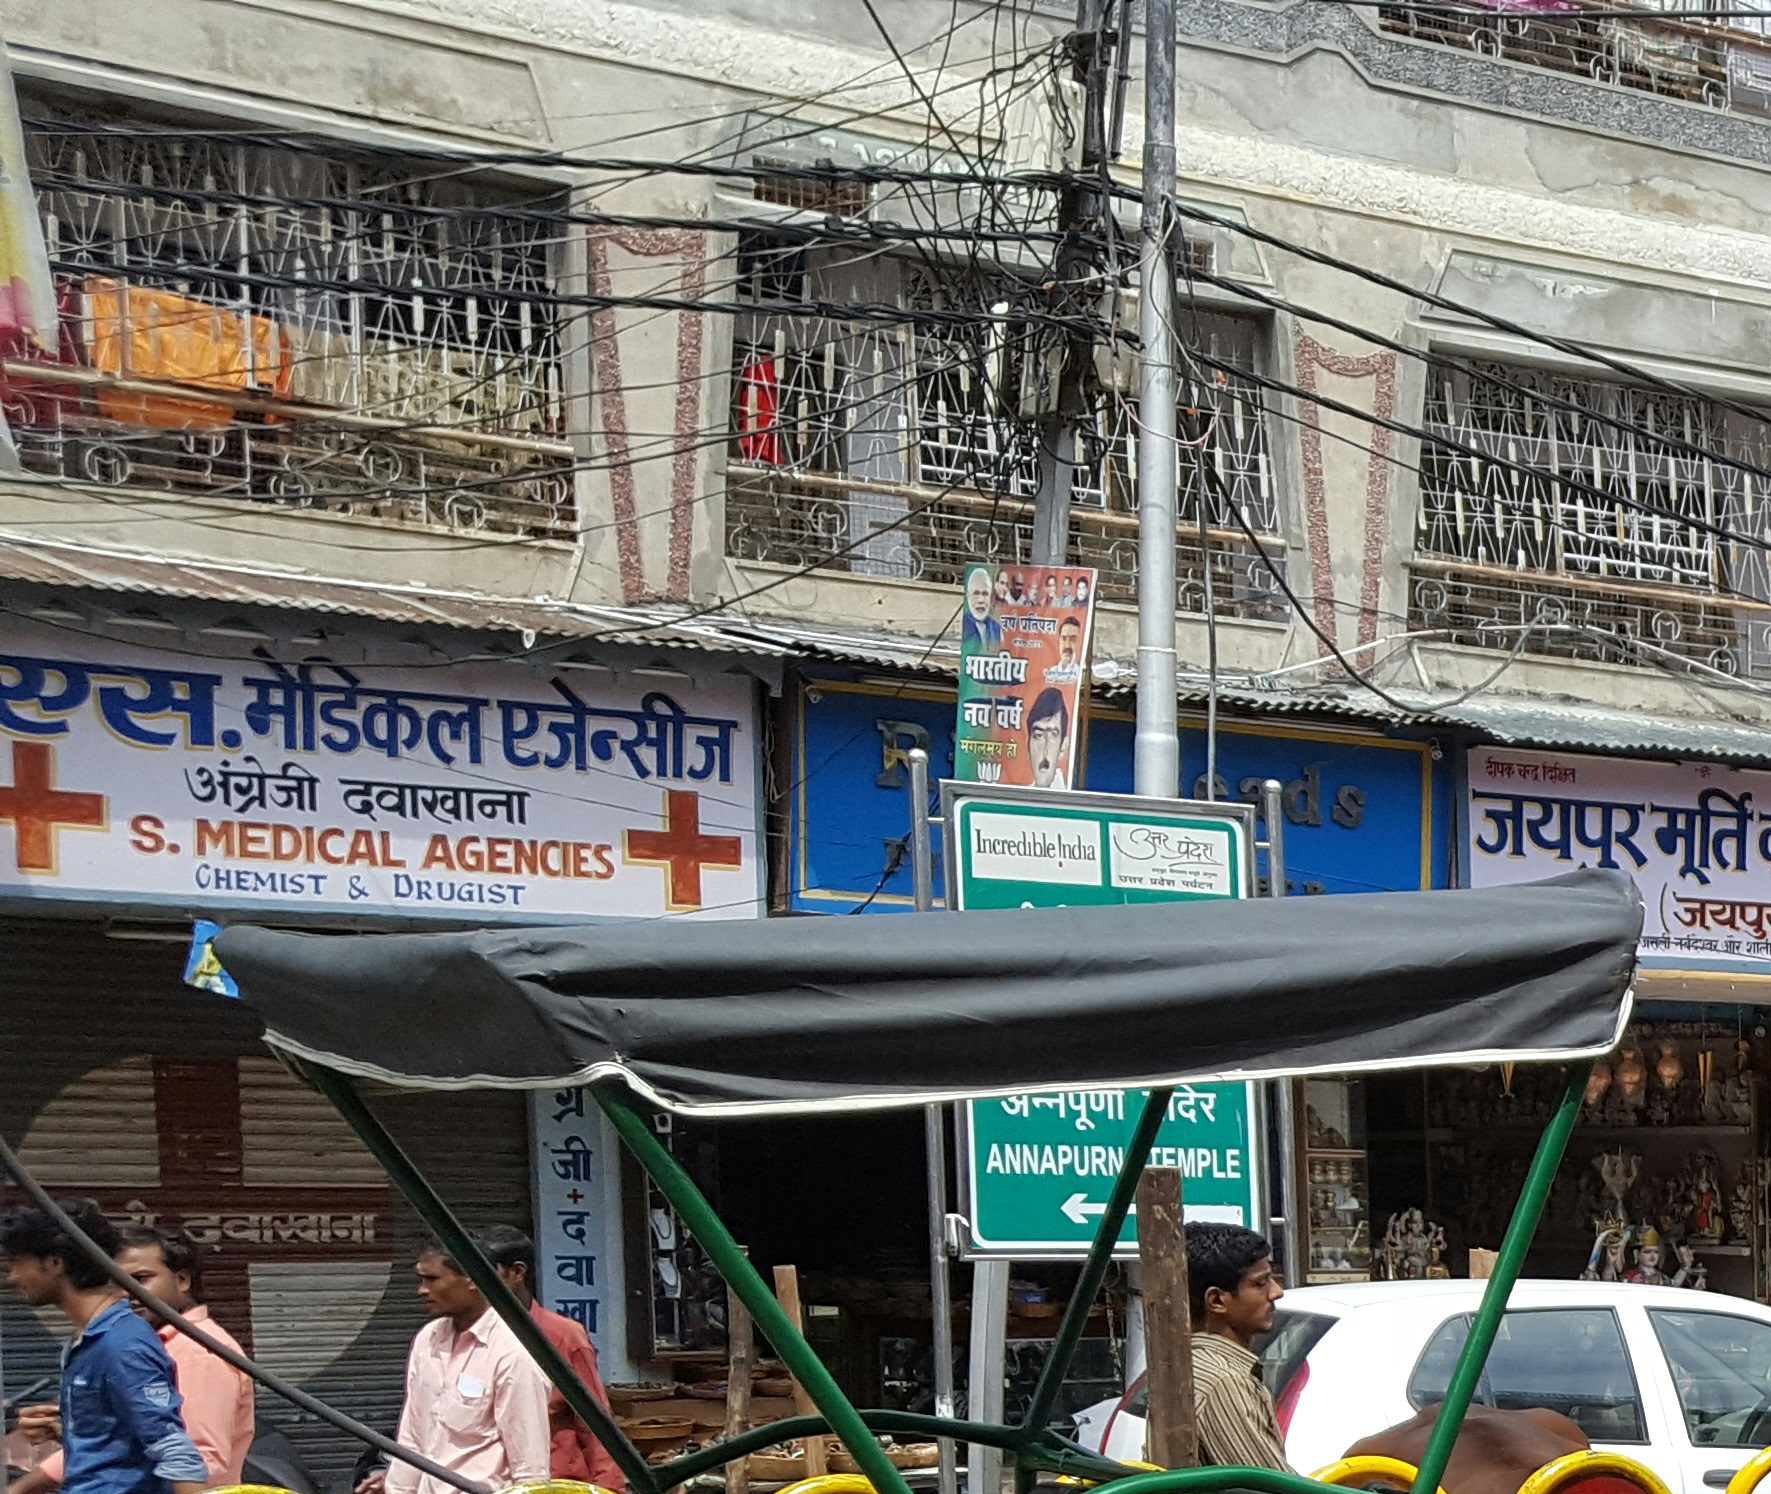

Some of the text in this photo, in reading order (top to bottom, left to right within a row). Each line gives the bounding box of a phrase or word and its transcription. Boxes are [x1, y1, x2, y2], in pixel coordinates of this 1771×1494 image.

[966, 650, 1028, 683] भारतीय
[243, 647, 490, 766] मेडिकल
[499, 676, 739, 784] एजेन्सीज
[963, 697, 1023, 729] नव वर्ष
[184, 757, 530, 825] अंग्रेजी दवाखाना
[131, 814, 615, 881] S. MEDICAL AGENCIES
[974, 828, 1055, 860] Incredible
[1650, 787, 1754, 887] मूर्ति
[195, 864, 526, 906] CHEMIST & DRUGIST
[986, 1143, 1130, 1178] ANNAPURN
[180, 1211, 380, 1251] दवाखाना
